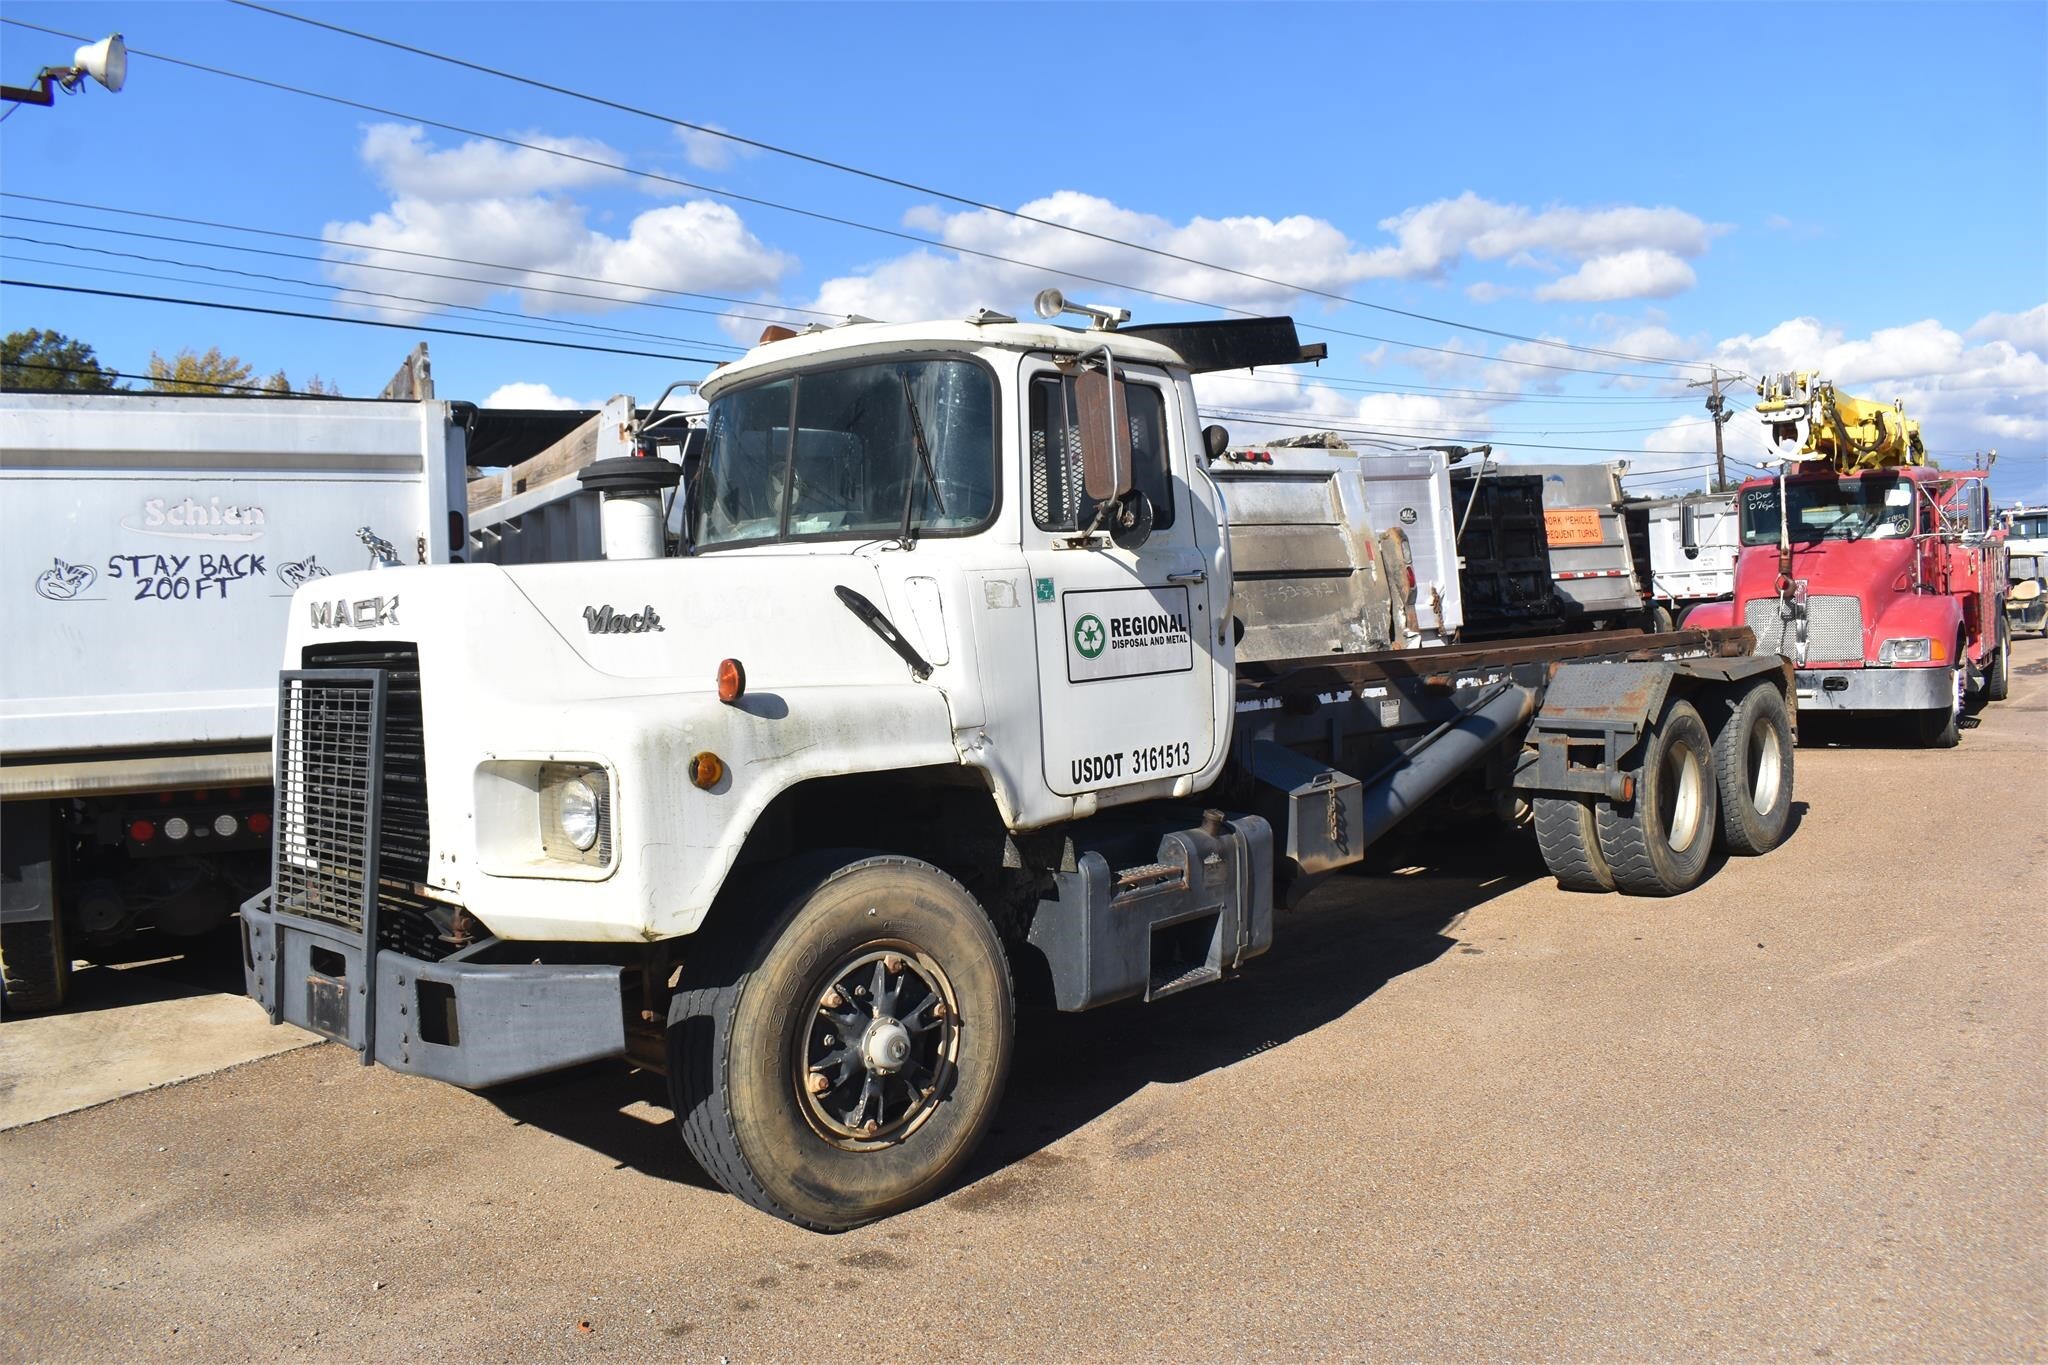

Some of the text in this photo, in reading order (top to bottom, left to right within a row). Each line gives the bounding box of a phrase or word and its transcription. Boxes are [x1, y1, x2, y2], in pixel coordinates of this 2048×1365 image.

[1565, 515, 1593, 525] VEHICLE
[1546, 528, 1599, 539] REQUENT TURNS
[107, 553, 267, 579] STAY BACK
[134, 576, 243, 600] 200 FT
[310, 594, 400, 629] MACK
[582, 604, 666, 634] Mack
[1110, 613, 1187, 638] REGIONAL
[1112, 634, 1188, 649] DISPOSAL AND METAL
[1071, 741, 1190, 785] USDOT 3161513
